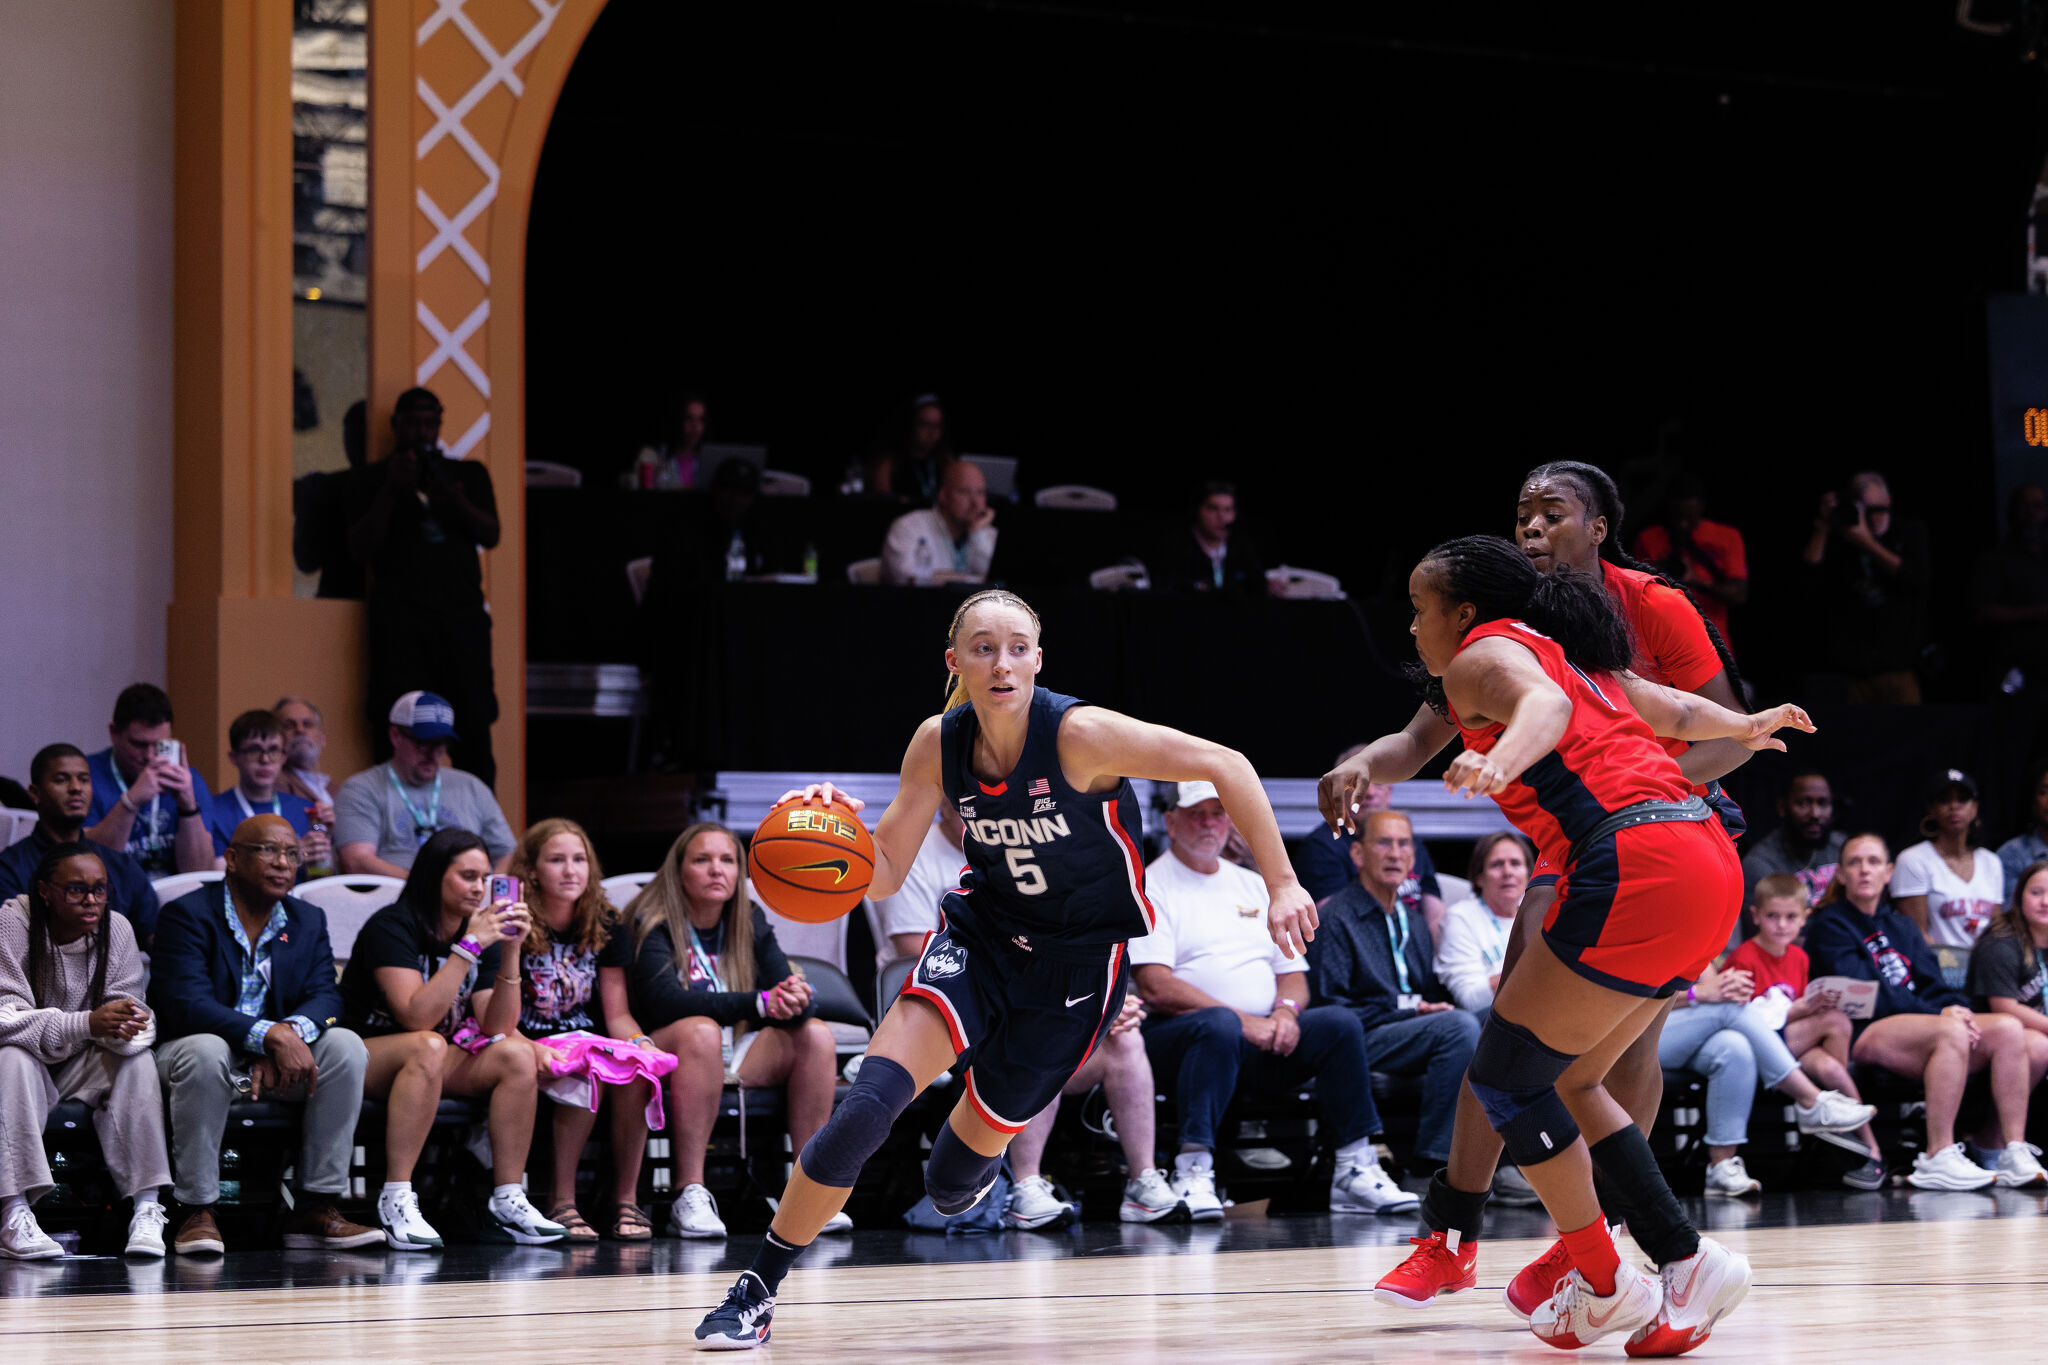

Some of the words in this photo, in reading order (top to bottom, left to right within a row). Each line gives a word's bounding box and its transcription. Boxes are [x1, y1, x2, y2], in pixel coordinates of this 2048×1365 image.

[1035, 797, 1050, 806] BIG
[788, 815, 856, 842] ELITE
[1005, 848, 1048, 895] 5
